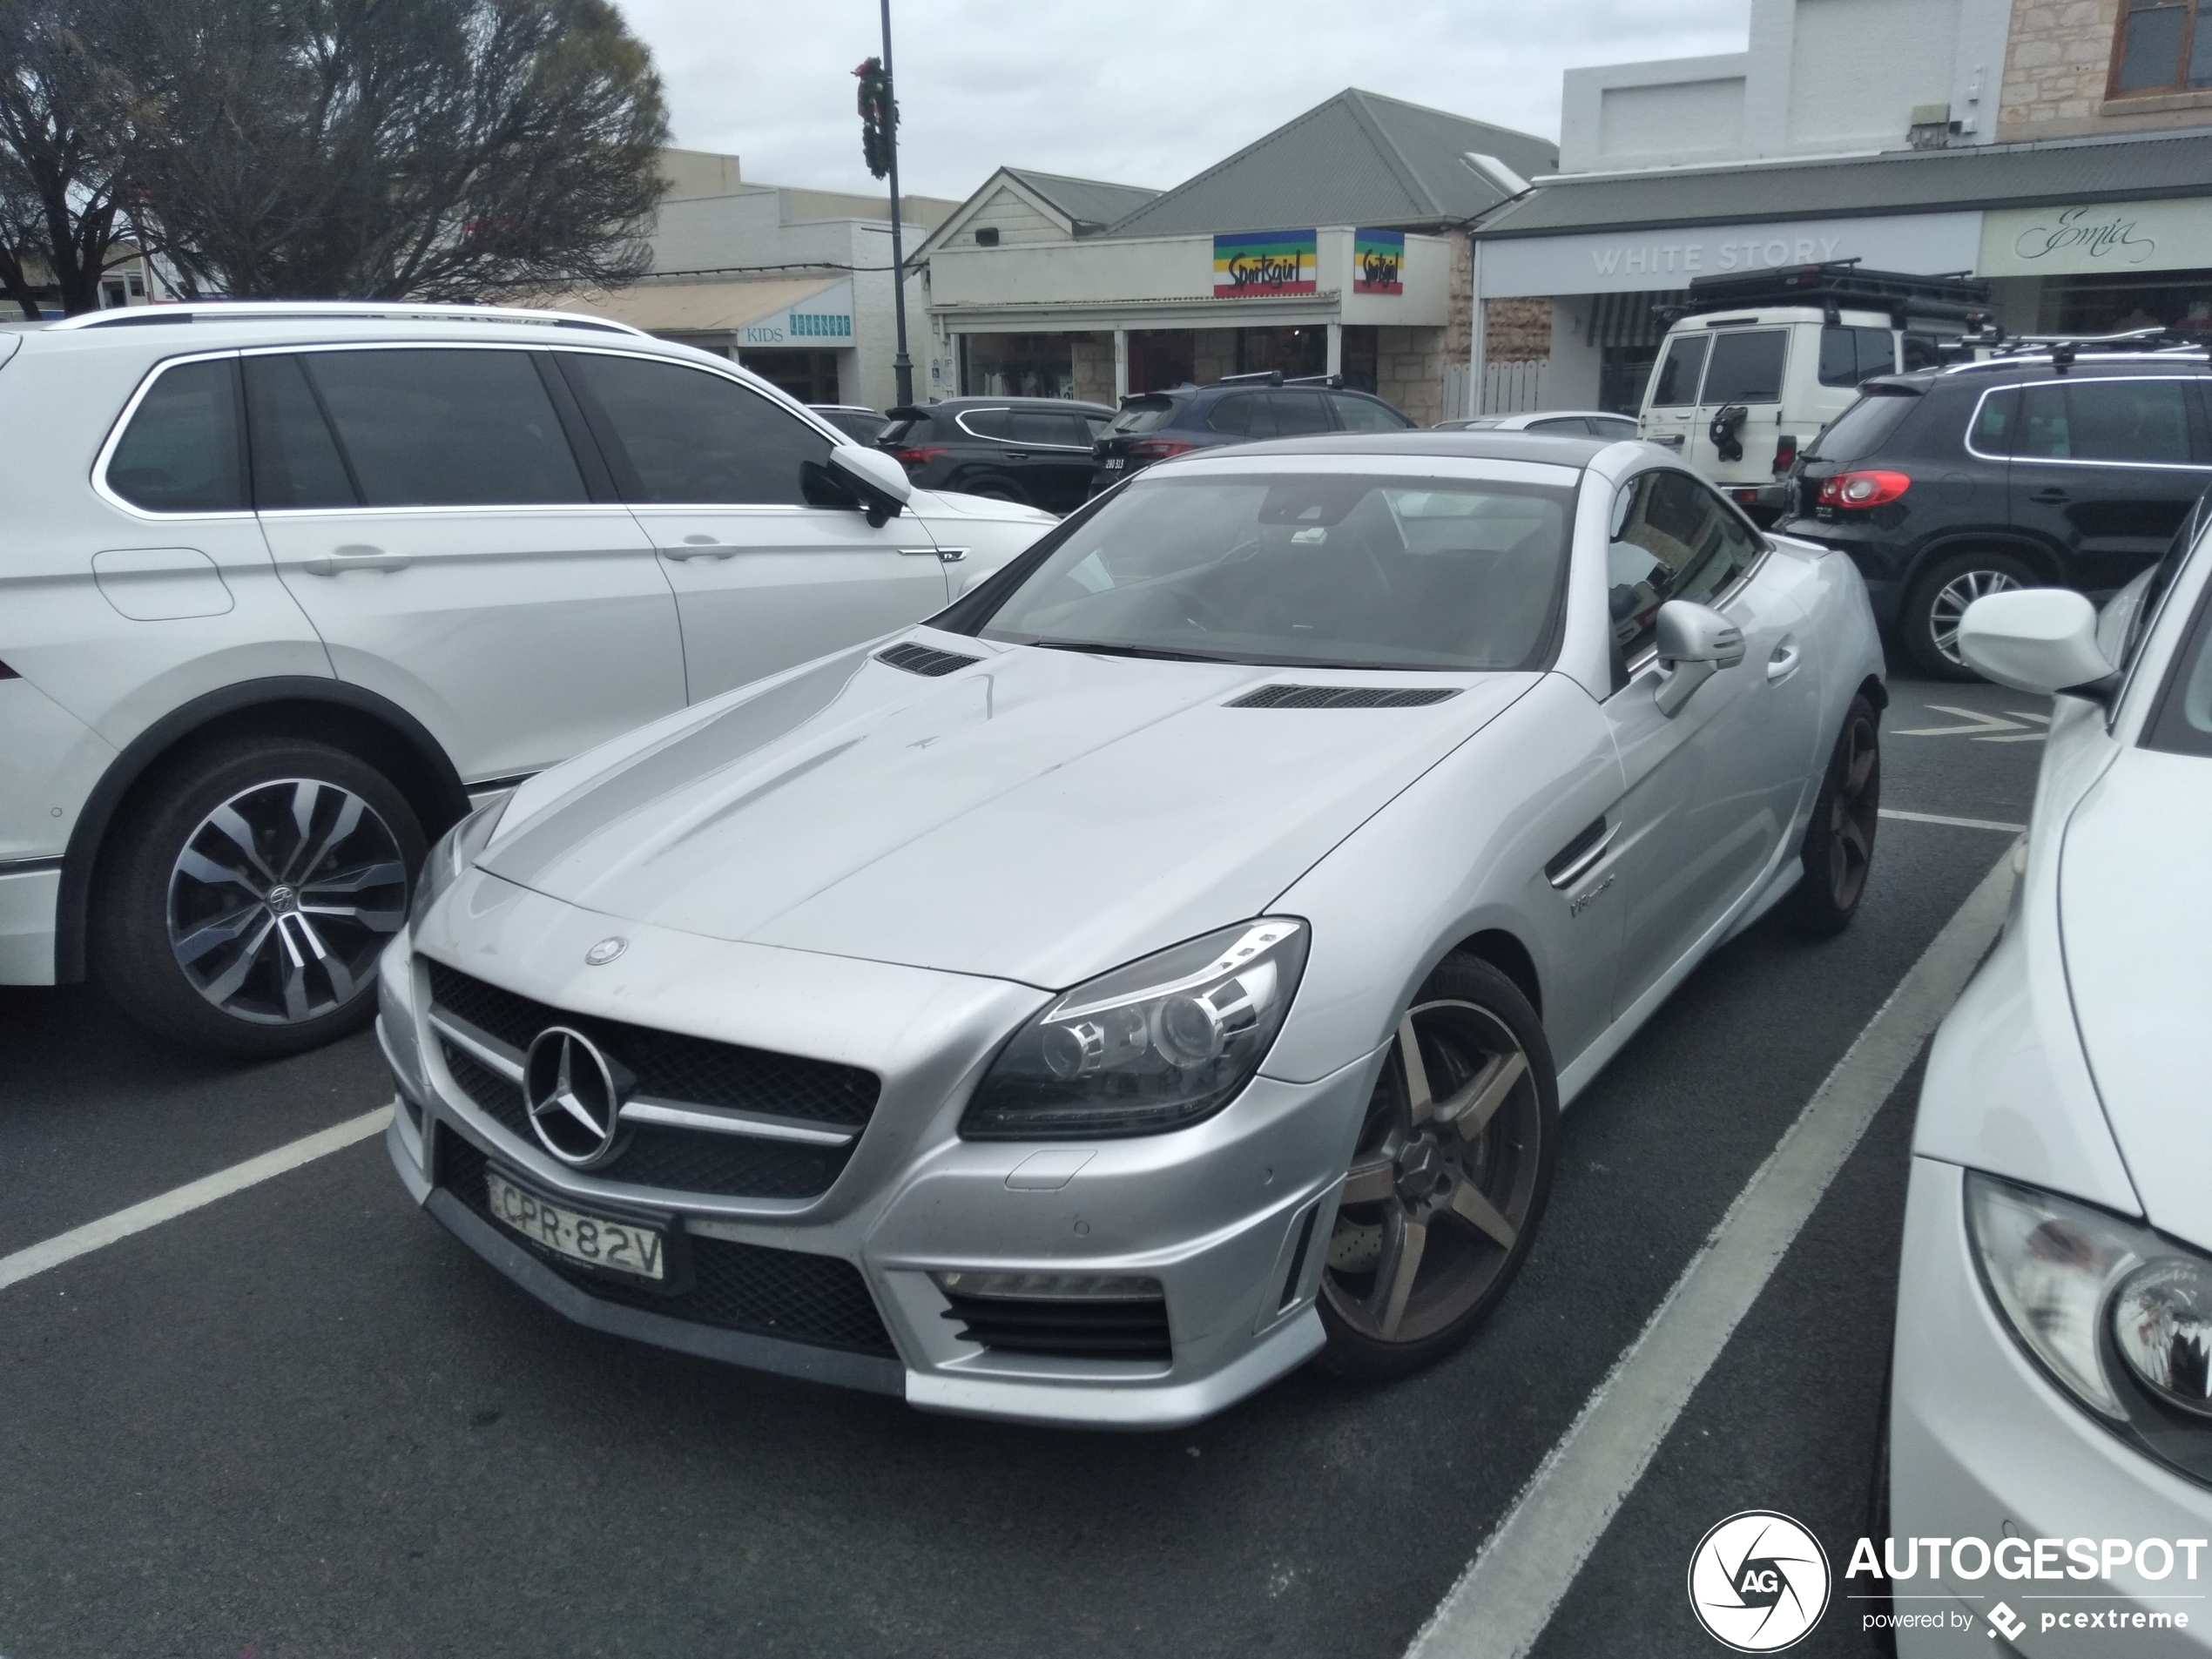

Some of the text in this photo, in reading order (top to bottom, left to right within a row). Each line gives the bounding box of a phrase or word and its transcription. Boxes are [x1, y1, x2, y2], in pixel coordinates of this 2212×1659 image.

[1228, 249, 1301, 291] Sportsgirl
[1591, 237, 1841, 276] WHITE STORY
[746, 327, 783, 343] KIDS
[790, 316, 851, 334] LEMONADE
